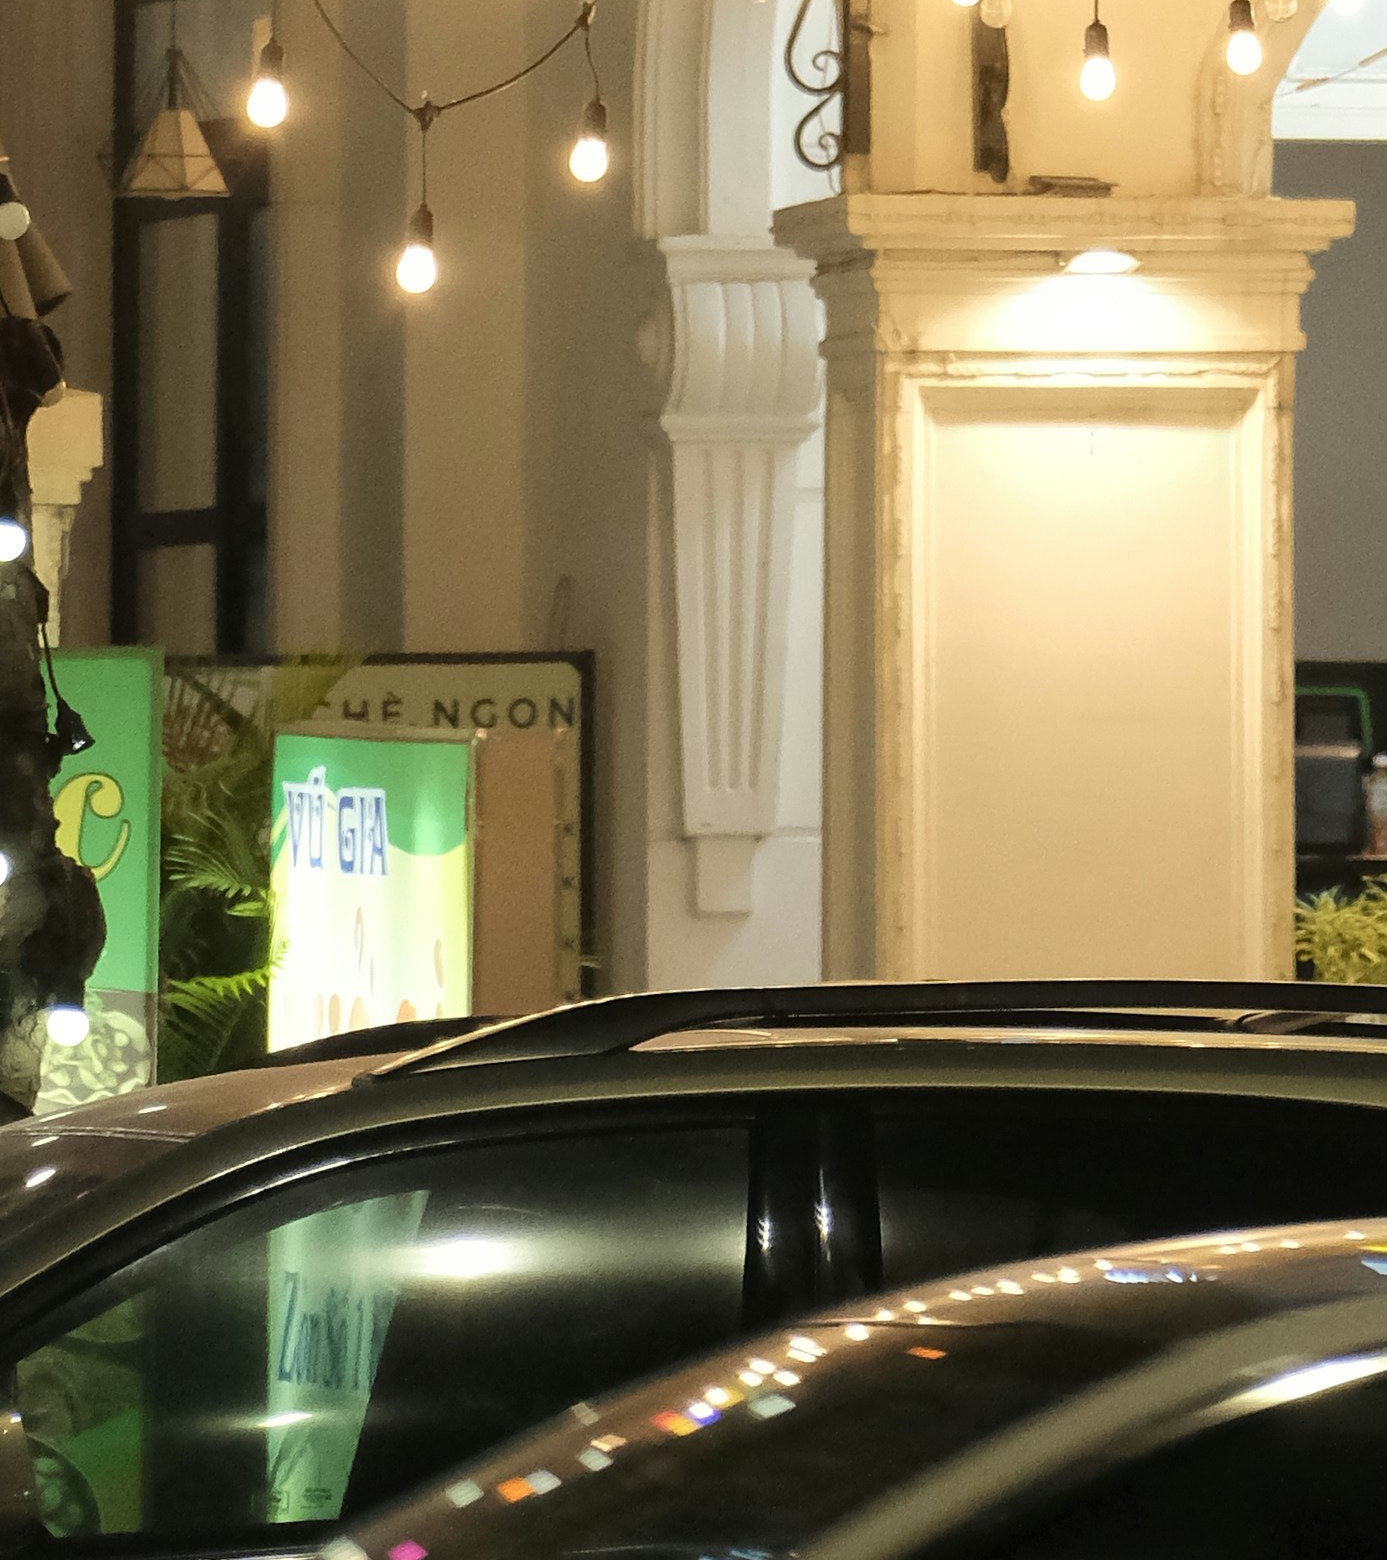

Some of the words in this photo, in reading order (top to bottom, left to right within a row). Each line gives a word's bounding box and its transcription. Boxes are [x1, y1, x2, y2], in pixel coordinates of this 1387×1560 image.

[314, 691, 403, 723] HÈ
[433, 698, 577, 729] NGON
[337, 792, 388, 876] GIA
